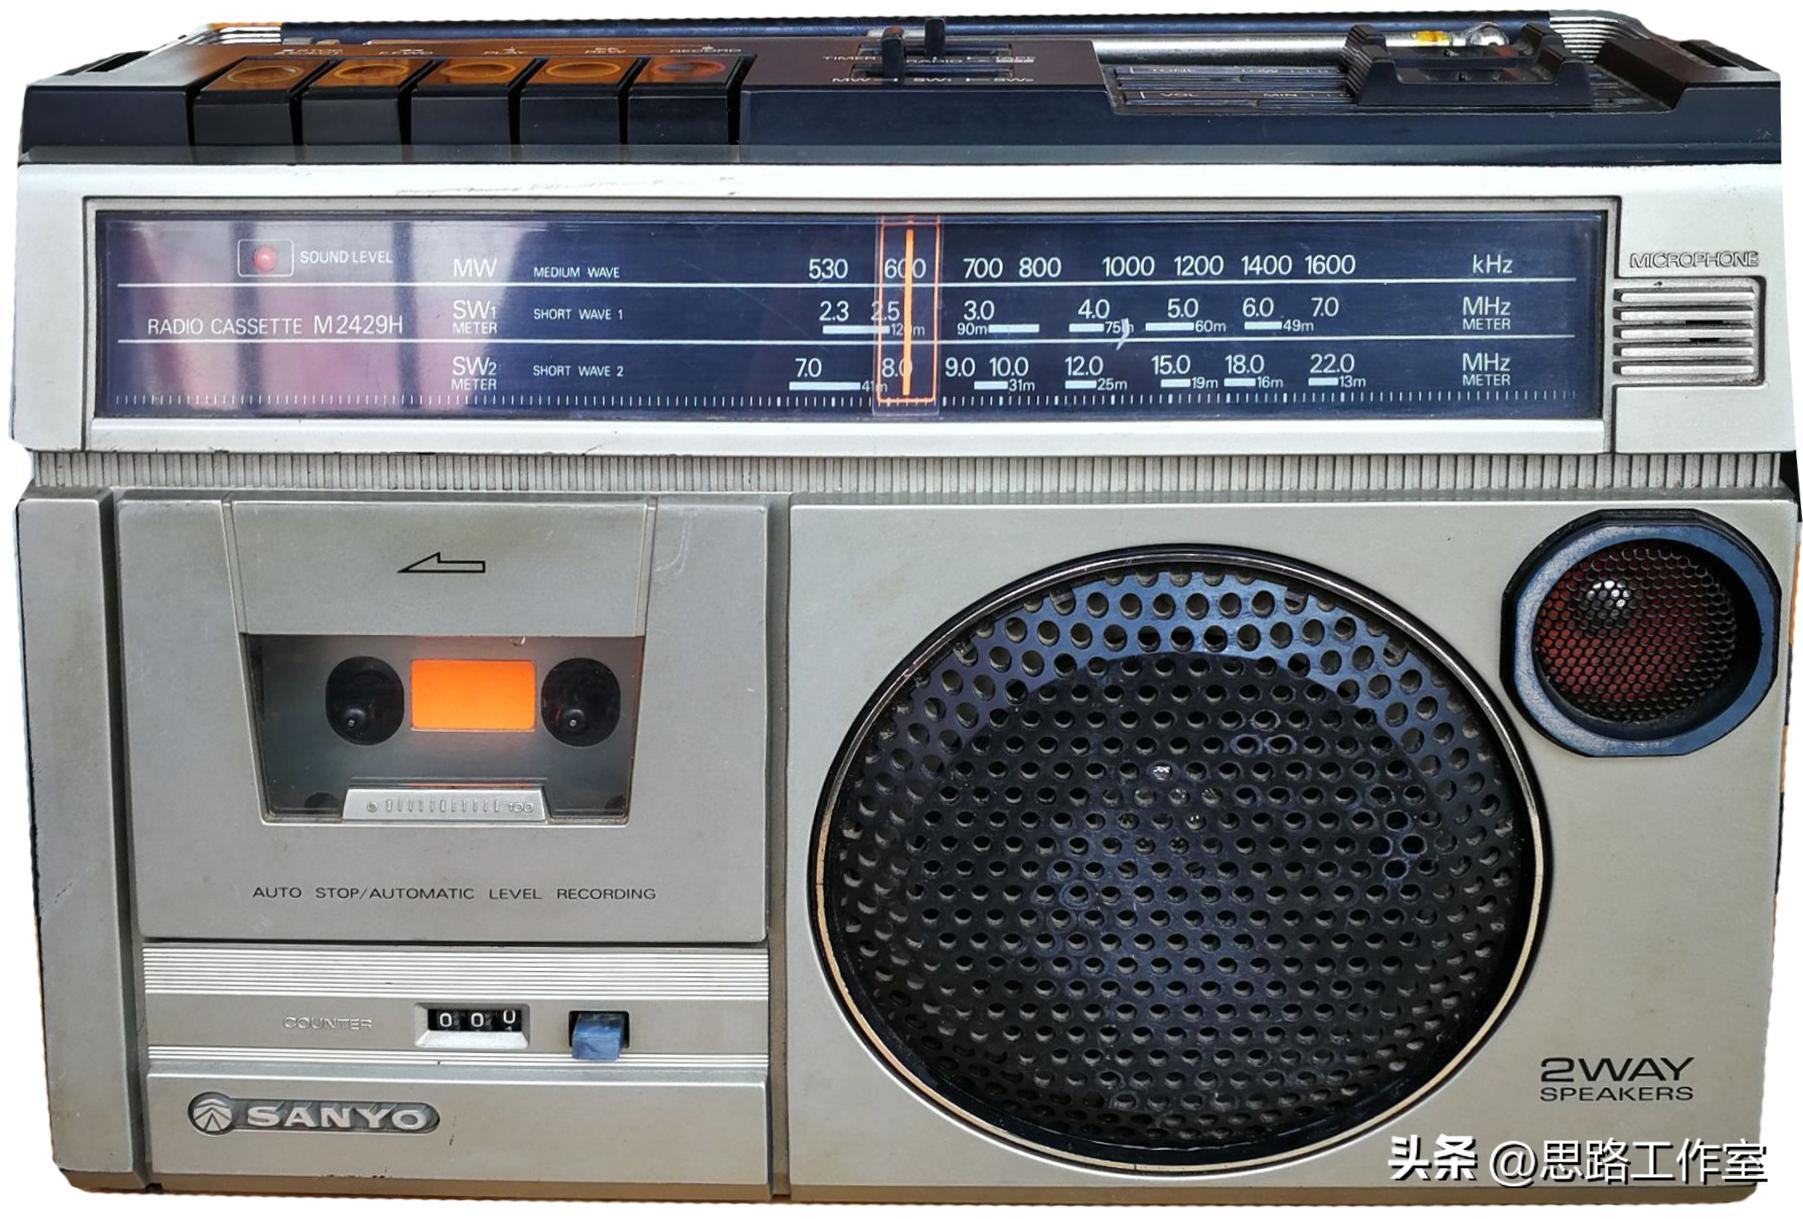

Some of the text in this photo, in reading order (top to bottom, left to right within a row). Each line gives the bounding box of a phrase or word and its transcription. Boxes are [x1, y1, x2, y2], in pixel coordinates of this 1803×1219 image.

[300, 250, 393, 264] SOUND LEVEL
[1629, 251, 1760, 269] MICROPHONE
[453, 259, 496, 278] MW
[533, 267, 620, 279] MEDIUM WAVE
[809, 259, 848, 279] 530
[963, 258, 1003, 279] 700
[1018, 257, 1061, 278] 800
[1102, 256, 1155, 277] 1000
[1174, 256, 1224, 276] 1200
[1241, 256, 1293, 275] 1400
[1305, 255, 1355, 275] 1600
[1473, 254, 1513, 274] kHz
[453, 300, 497, 321] SW1
[533, 308, 623, 320] SHORT WAVE 1
[819, 296, 1512, 321] 2.3 2.5 3.0 4.0 5.0 6.0 7.0 MHz
[148, 319, 204, 335] RADIO
[211, 319, 303, 335] CASSETTE
[453, 321, 498, 335] METER
[891, 323, 925, 336] 12m
[957, 323, 988, 335] 90m
[1195, 320, 1226, 332] 60m
[1283, 319, 1314, 331] 49m
[1463, 318, 1511, 330] METER
[452, 357, 497, 377] SW2
[533, 365, 624, 377] SHORT WAVE 2
[795, 358, 822, 378] 7.0
[945, 357, 976, 377] 9.0
[989, 356, 1029, 376] 10.0
[1065, 356, 1104, 376] 12.0
[1152, 355, 1191, 375] 15.0
[1225, 355, 1265, 374] 18.0
[1310, 354, 1355, 374] 22.0
[1463, 352, 1511, 372] MHz
[452, 378, 497, 391] METER
[1009, 379, 1035, 391] 31m
[1097, 378, 1127, 390] 25m
[1192, 377, 1218, 389] 19m
[1257, 376, 1283, 389] 16m
[1338, 376, 1366, 388] 13m
[1463, 374, 1511, 387] METER
[252, 886, 657, 901] AUTO STOP/AUTOMATIC LEVEL RECORDING
[284, 1016, 373, 1030] COUNTER
[1540, 1057, 1695, 1082] 2WAY
[1539, 1086, 1694, 1101] SPEAKERS
[247, 1105, 428, 1130] SANYO
